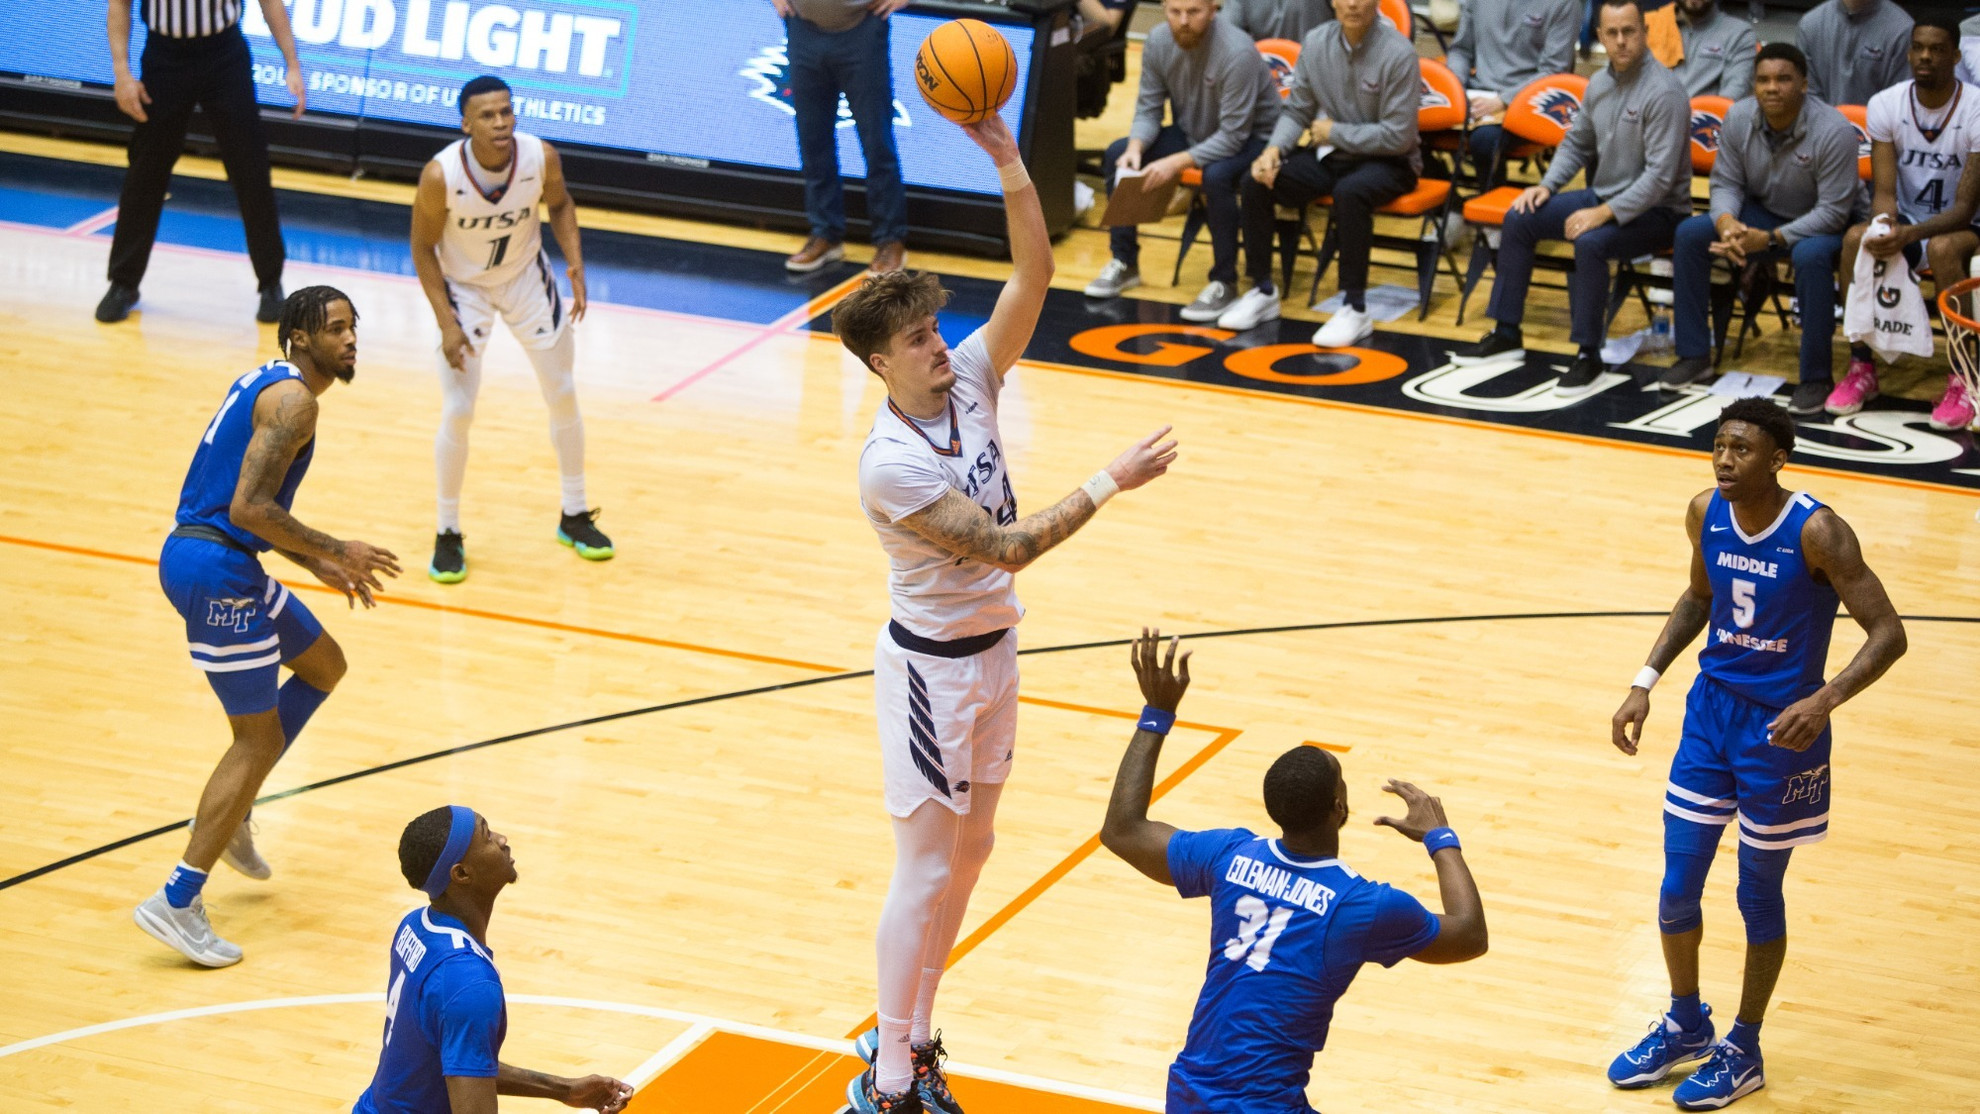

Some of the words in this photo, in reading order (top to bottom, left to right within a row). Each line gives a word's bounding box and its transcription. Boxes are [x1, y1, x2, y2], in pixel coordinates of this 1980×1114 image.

[402, 0, 621, 77] LIGHT
[309, 71, 407, 101] SPONSOR
[511, 95, 606, 126] THLETICS
[458, 207, 531, 230] UTSA
[1914, 178, 1948, 214] 4
[485, 234, 511, 271] 1
[1069, 323, 1408, 386] GO
[1716, 551, 1779, 579] MIDDLE
[1731, 577, 1756, 629] 5
[1225, 854, 1337, 917] COLEMAN-JONES
[1224, 894, 1295, 973] 31
